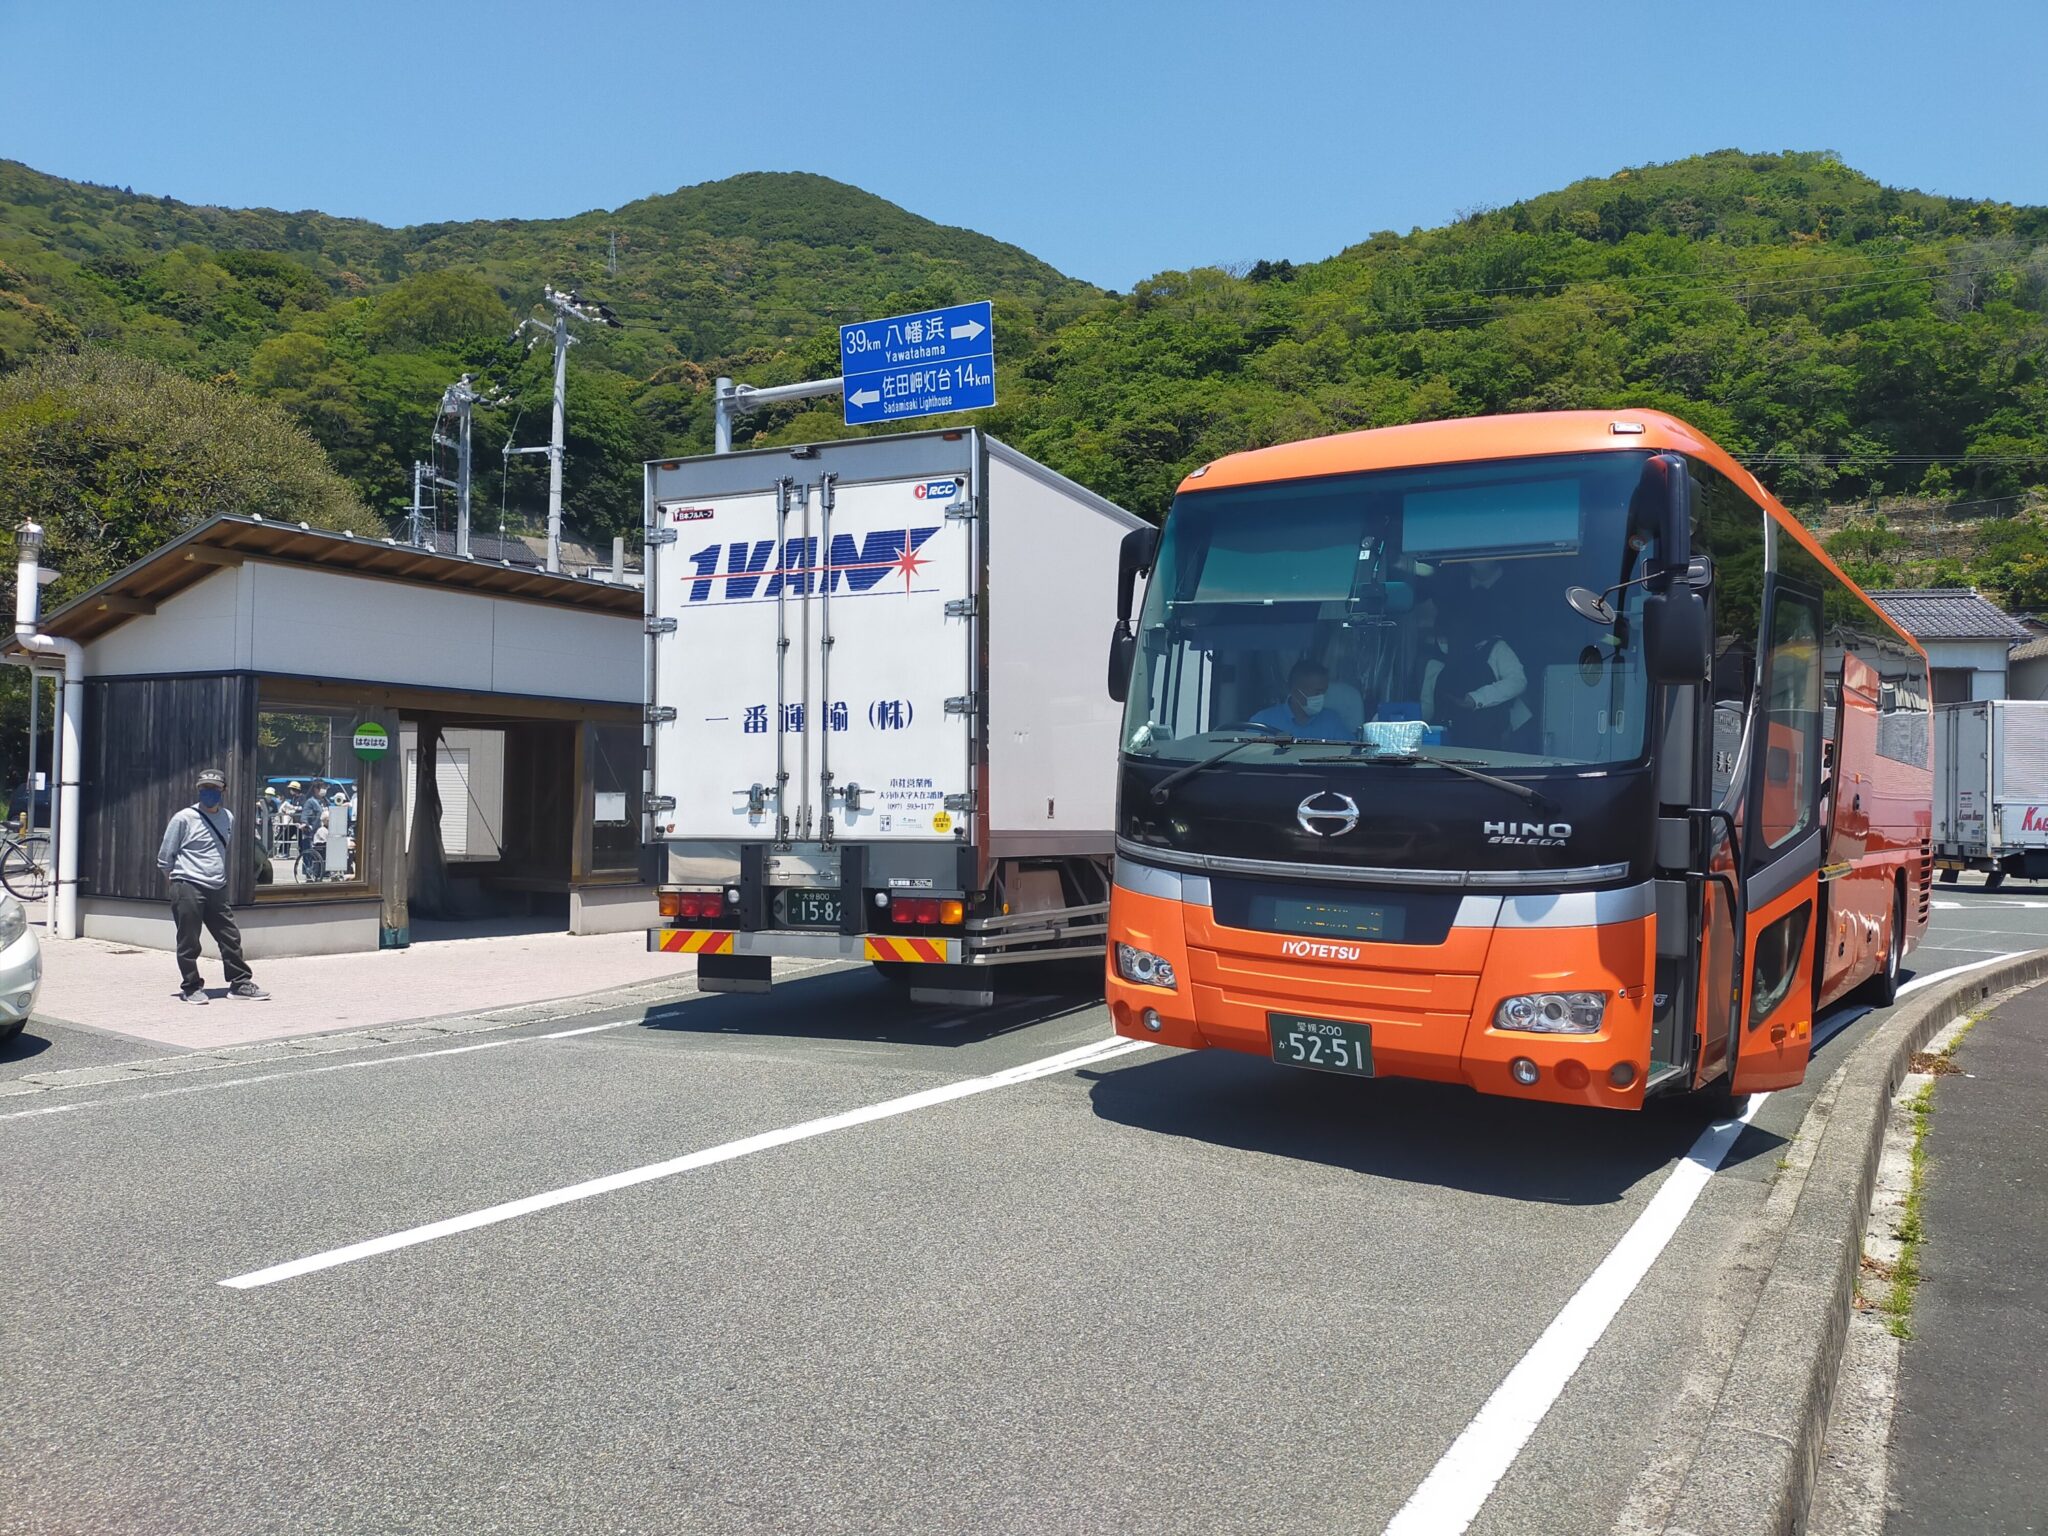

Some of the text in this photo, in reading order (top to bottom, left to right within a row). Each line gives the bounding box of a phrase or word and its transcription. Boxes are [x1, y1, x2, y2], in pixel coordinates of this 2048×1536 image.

[886, 316, 945, 348] 八幡浜
[886, 345, 946, 363] Yawatahama
[882, 368, 951, 398] 佐田岬灯台
[883, 395, 953, 414] Sadamisaki Lighthouse
[679, 510, 713, 520] 日本フルハーフ
[356, 737, 386, 747] はなはな
[1483, 821, 1572, 838] HINO
[1487, 835, 1566, 847] SELEGA
[1282, 941, 1360, 960] IYOTETSU
[1289, 1032, 1363, 1070] 52-51
